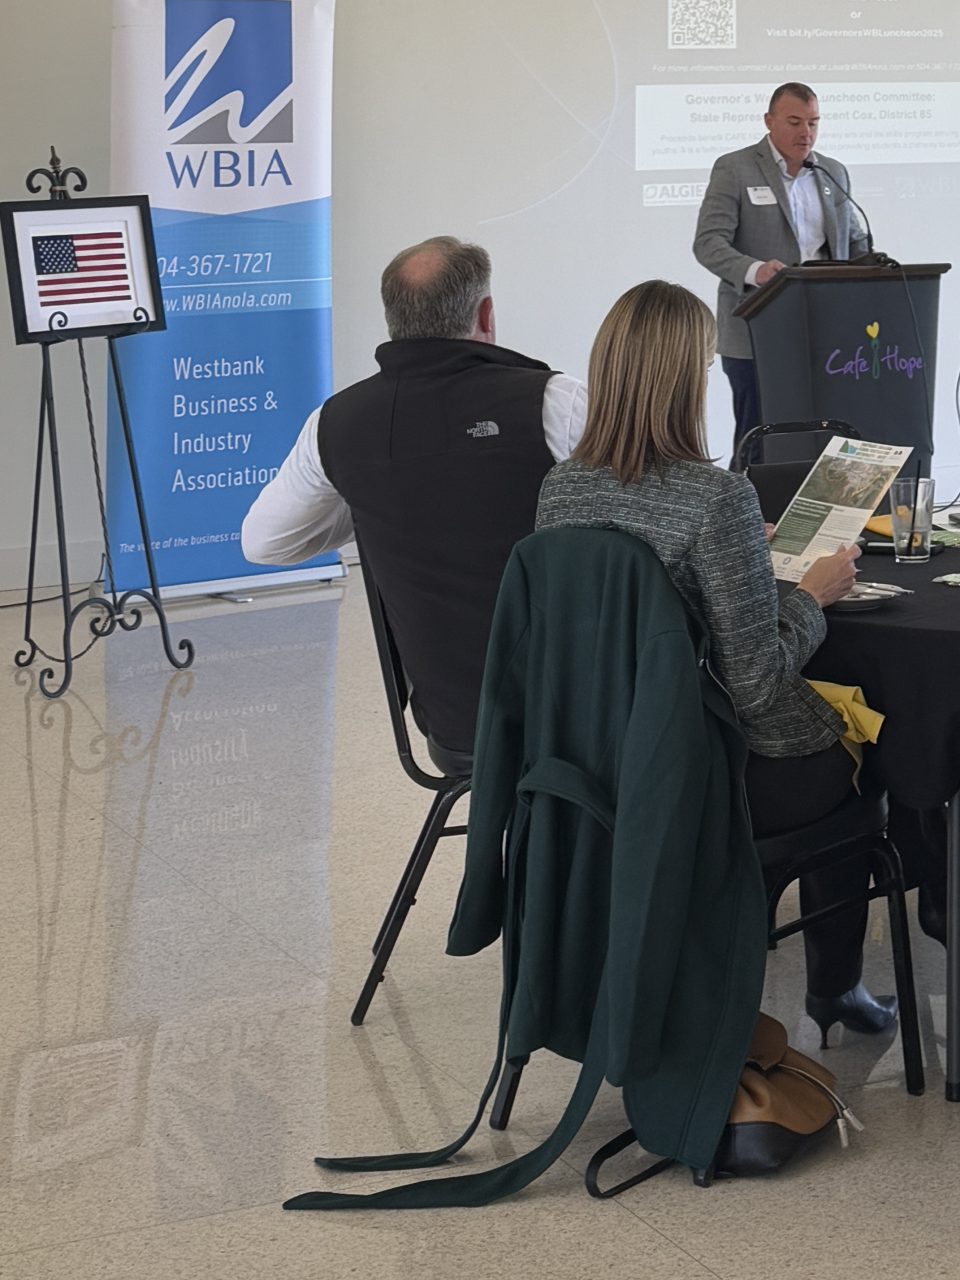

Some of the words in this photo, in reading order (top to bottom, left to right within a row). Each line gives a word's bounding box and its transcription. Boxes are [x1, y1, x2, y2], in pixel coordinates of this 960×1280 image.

[850, 10, 862, 19] or
[766, 28, 787, 37] Visit
[685, 94, 751, 105] Governor's
[873, 92, 936, 102] Committee:
[690, 112, 719, 123] State
[879, 109, 917, 120] District
[920, 109, 932, 119] 85
[165, 149, 293, 189] WBIA
[659, 184, 702, 199] ALGIE
[157, 252, 272, 278] 04-367-1721
[164, 291, 292, 312] w.WBIAnola.com
[173, 355, 265, 381] Westbank
[825, 346, 870, 380] Cafe
[881, 345, 923, 379] Hope
[173, 394, 257, 418] Business
[264, 391, 278, 410] &
[173, 432, 252, 455] Industry
[171, 465, 280, 493] Association
[119, 543, 135, 554] The
[137, 541, 160, 552] voce
[162, 537, 174, 548] of
[173, 536, 190, 548] the
[190, 533, 229, 545] business
